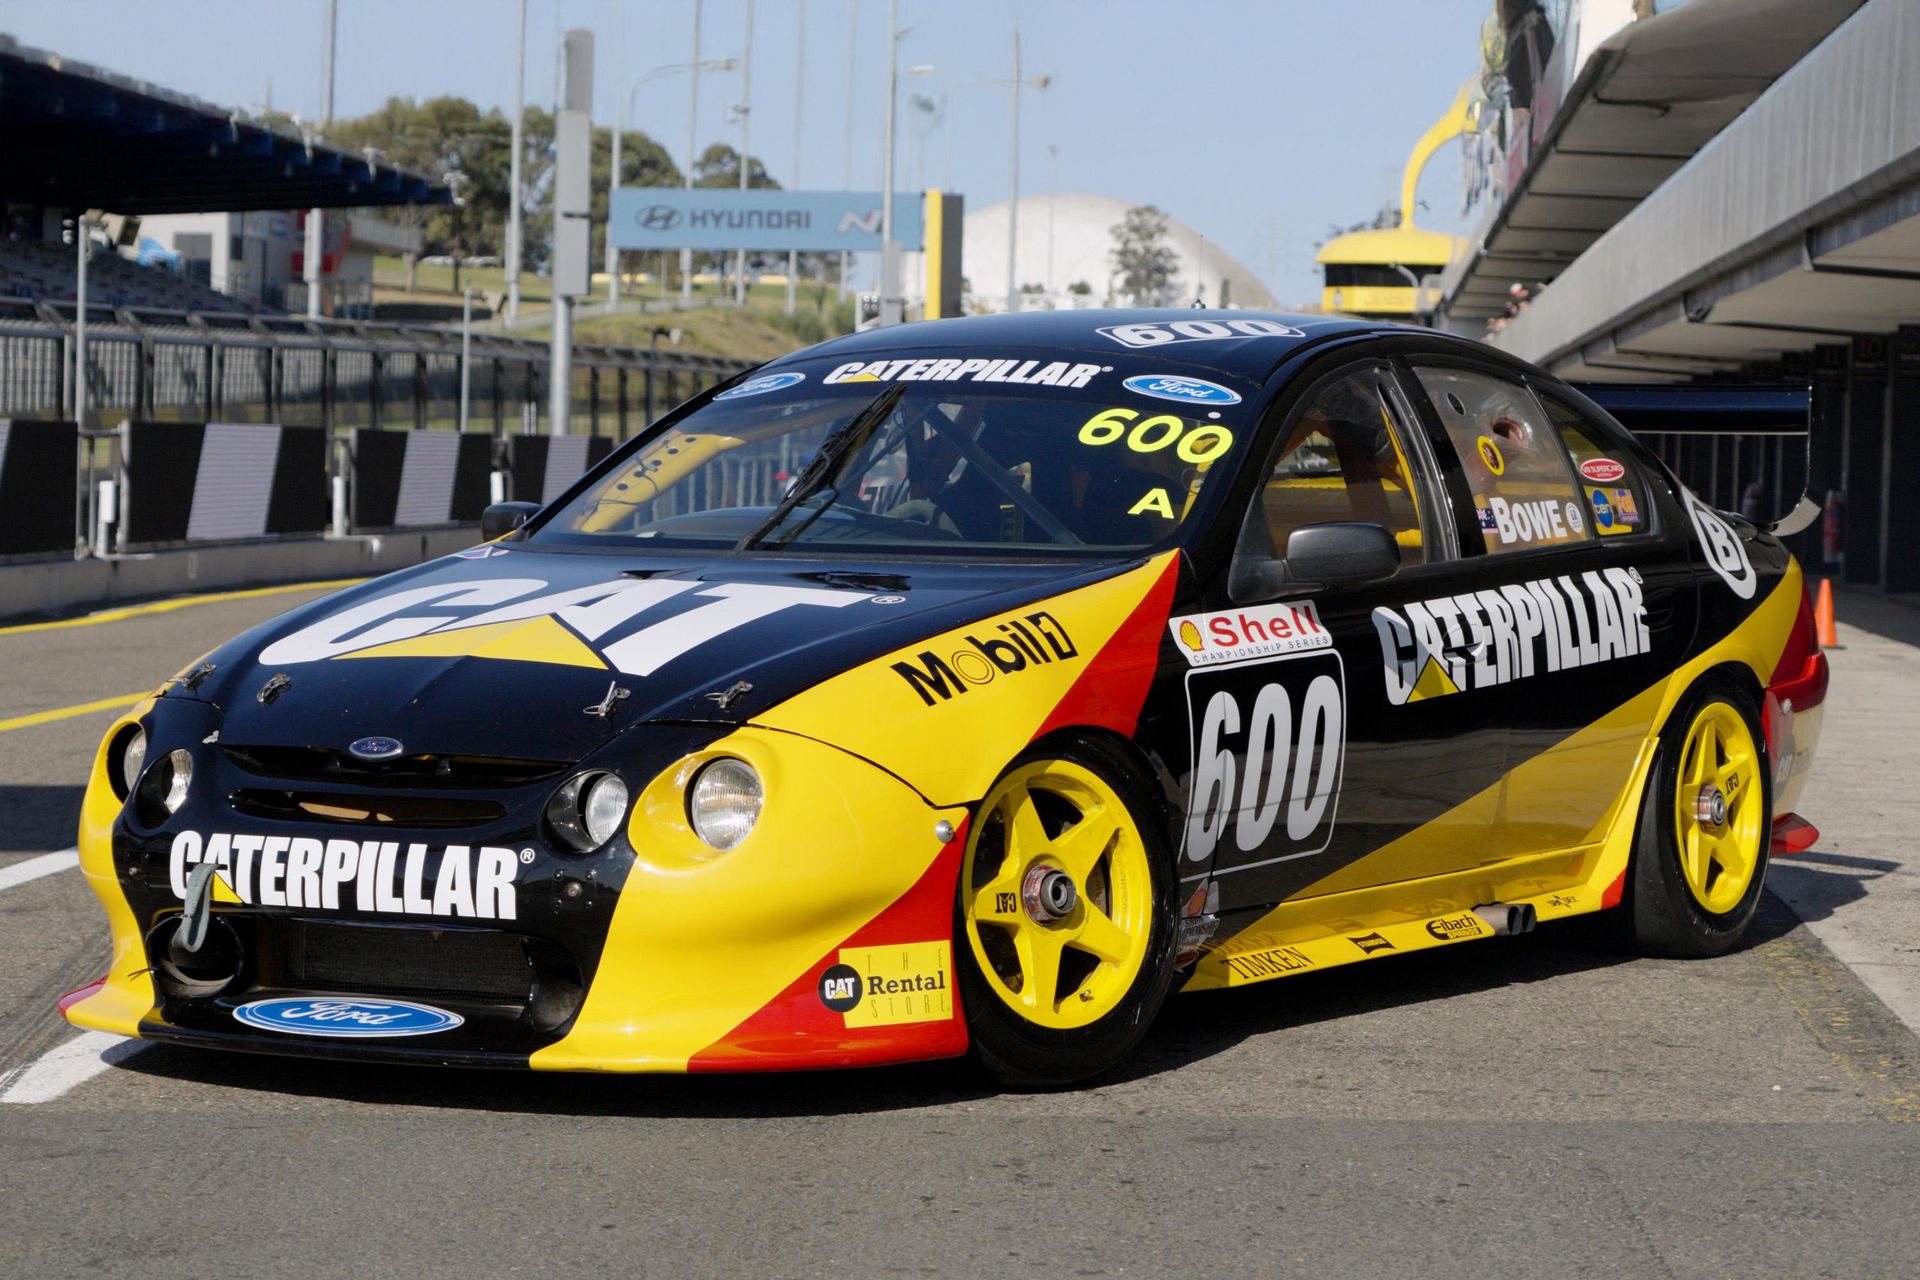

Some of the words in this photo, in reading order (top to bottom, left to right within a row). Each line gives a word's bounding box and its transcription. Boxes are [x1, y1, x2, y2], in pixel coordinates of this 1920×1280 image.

[690, 209, 811, 229] HYUNDAI
[1111, 319, 1291, 346] 600
[1077, 407, 1234, 464] 600
[1127, 488, 1175, 519] A
[1489, 497, 1568, 544] BOWE
[1208, 605, 1321, 647] Shell
[1194, 643, 1281, 664] CHAMPIONSHIP
[1288, 636, 1329, 649] SERIES
[1187, 675, 1341, 862] 600
[1426, 914, 1478, 940] Eibach
[1220, 946, 1315, 979] TIMKEN
[824, 976, 855, 999] CAT
[867, 971, 946, 996] Rental
[283, 1001, 413, 1027] Ford
